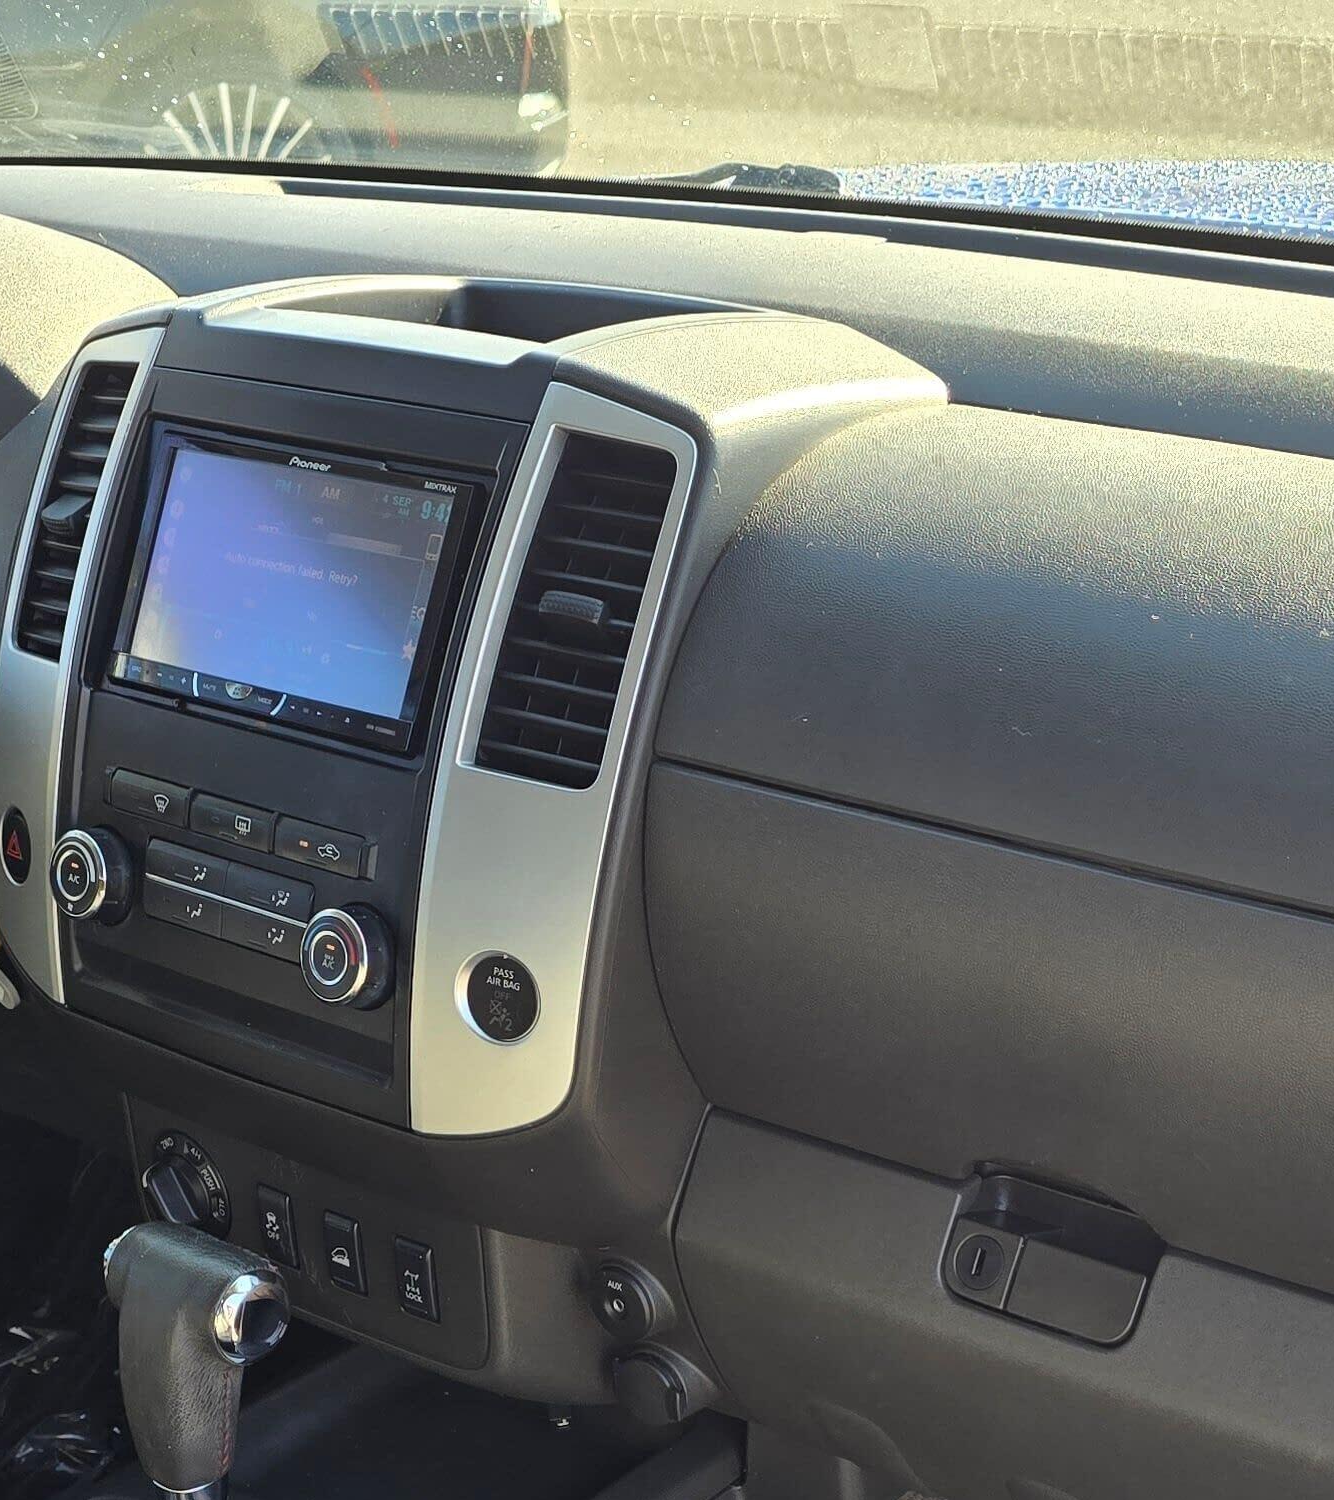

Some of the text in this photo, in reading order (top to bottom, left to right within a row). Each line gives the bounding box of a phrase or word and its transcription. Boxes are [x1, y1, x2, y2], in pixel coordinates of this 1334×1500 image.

[289, 456, 331, 472] Pioneer
[321, 487, 341, 500] AM
[424, 480, 458, 494] MIXTRAX
[329, 571, 359, 587] Retry?
[68, 874, 80, 884] A/C
[322, 960, 334, 971] A/C
[493, 966, 514, 980] PASS
[486, 975, 521, 991] AIR BAG
[201, 1168, 216, 1191] PUSH
[607, 1279, 623, 1291] AUX
